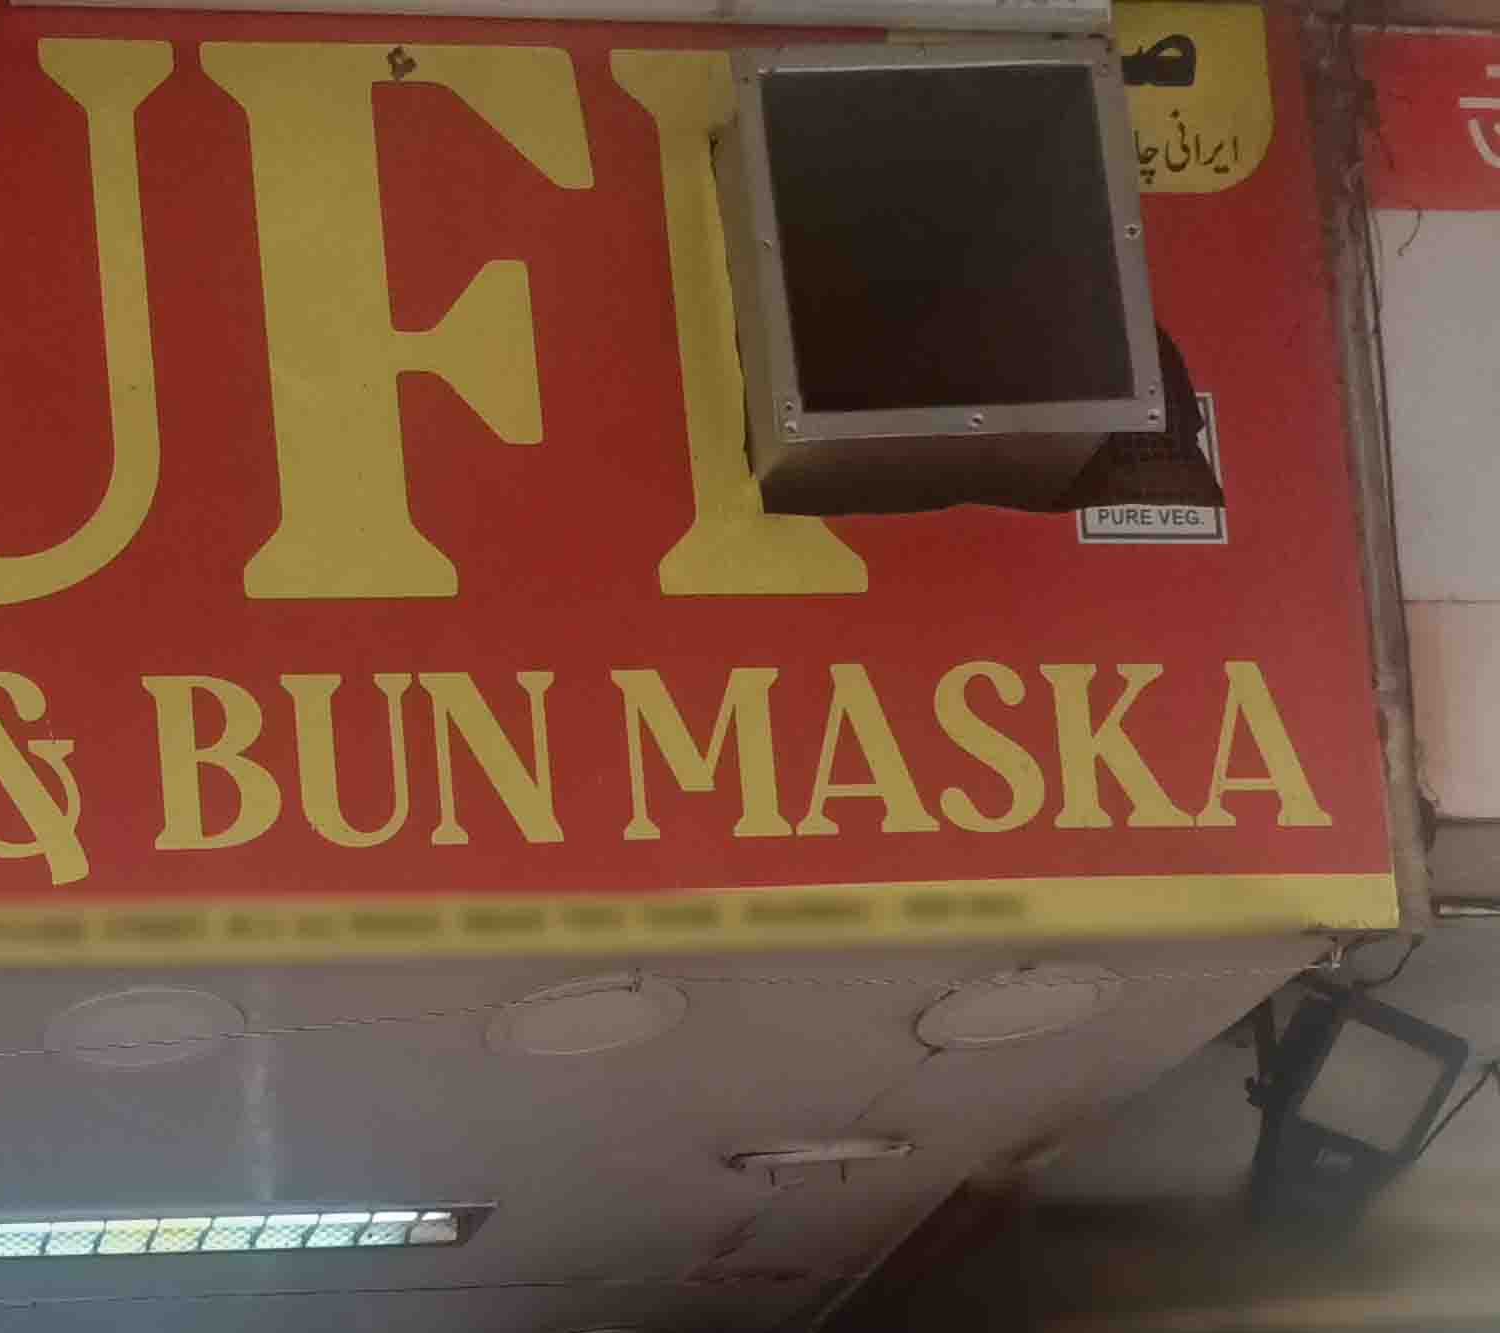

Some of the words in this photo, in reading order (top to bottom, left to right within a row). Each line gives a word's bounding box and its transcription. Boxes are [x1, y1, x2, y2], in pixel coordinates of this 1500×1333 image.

[1099, 508, 1152, 526] PURE
[1156, 508, 1205, 526] VEG.
[143, 671, 565, 849] BUN
[612, 661, 1333, 840] MASKA
